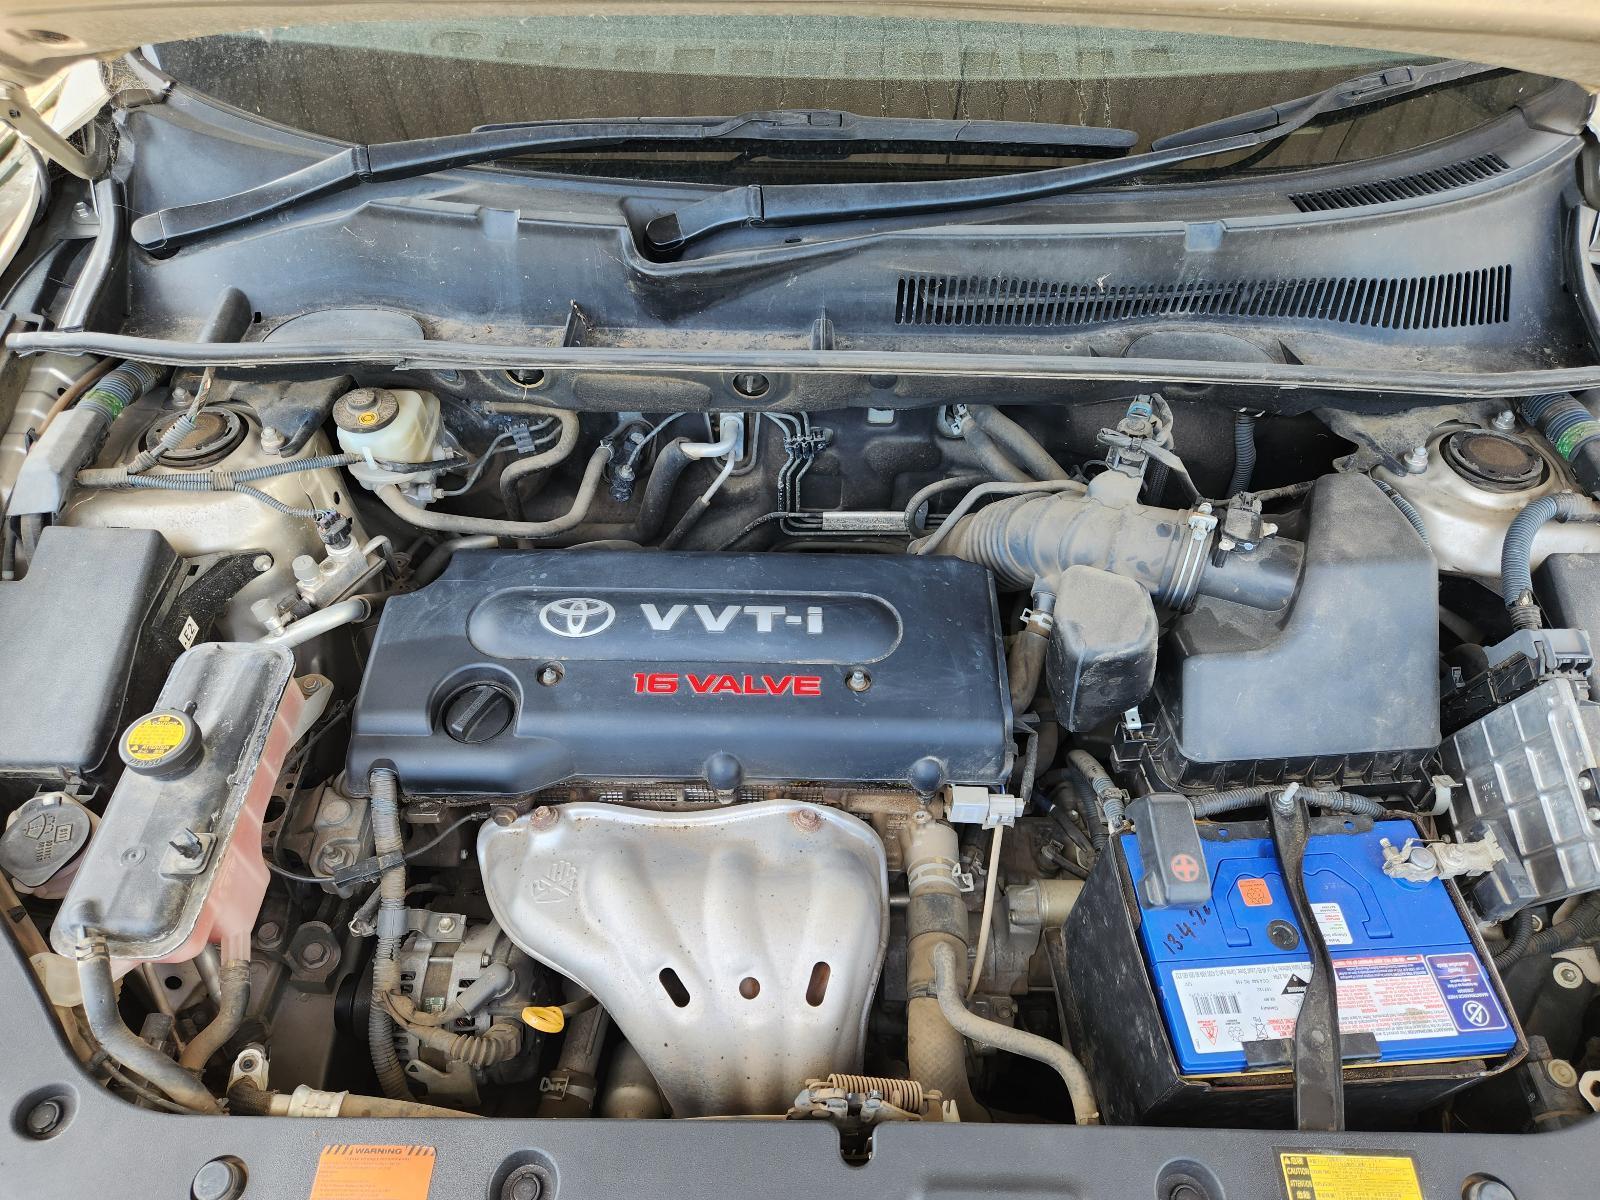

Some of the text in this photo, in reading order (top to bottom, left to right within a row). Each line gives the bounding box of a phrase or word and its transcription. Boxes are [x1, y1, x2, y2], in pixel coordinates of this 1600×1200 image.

[640, 603, 823, 634] VVT-i
[634, 672, 822, 696] 16 VALVE
[354, 1147, 403, 1155] WARNING
